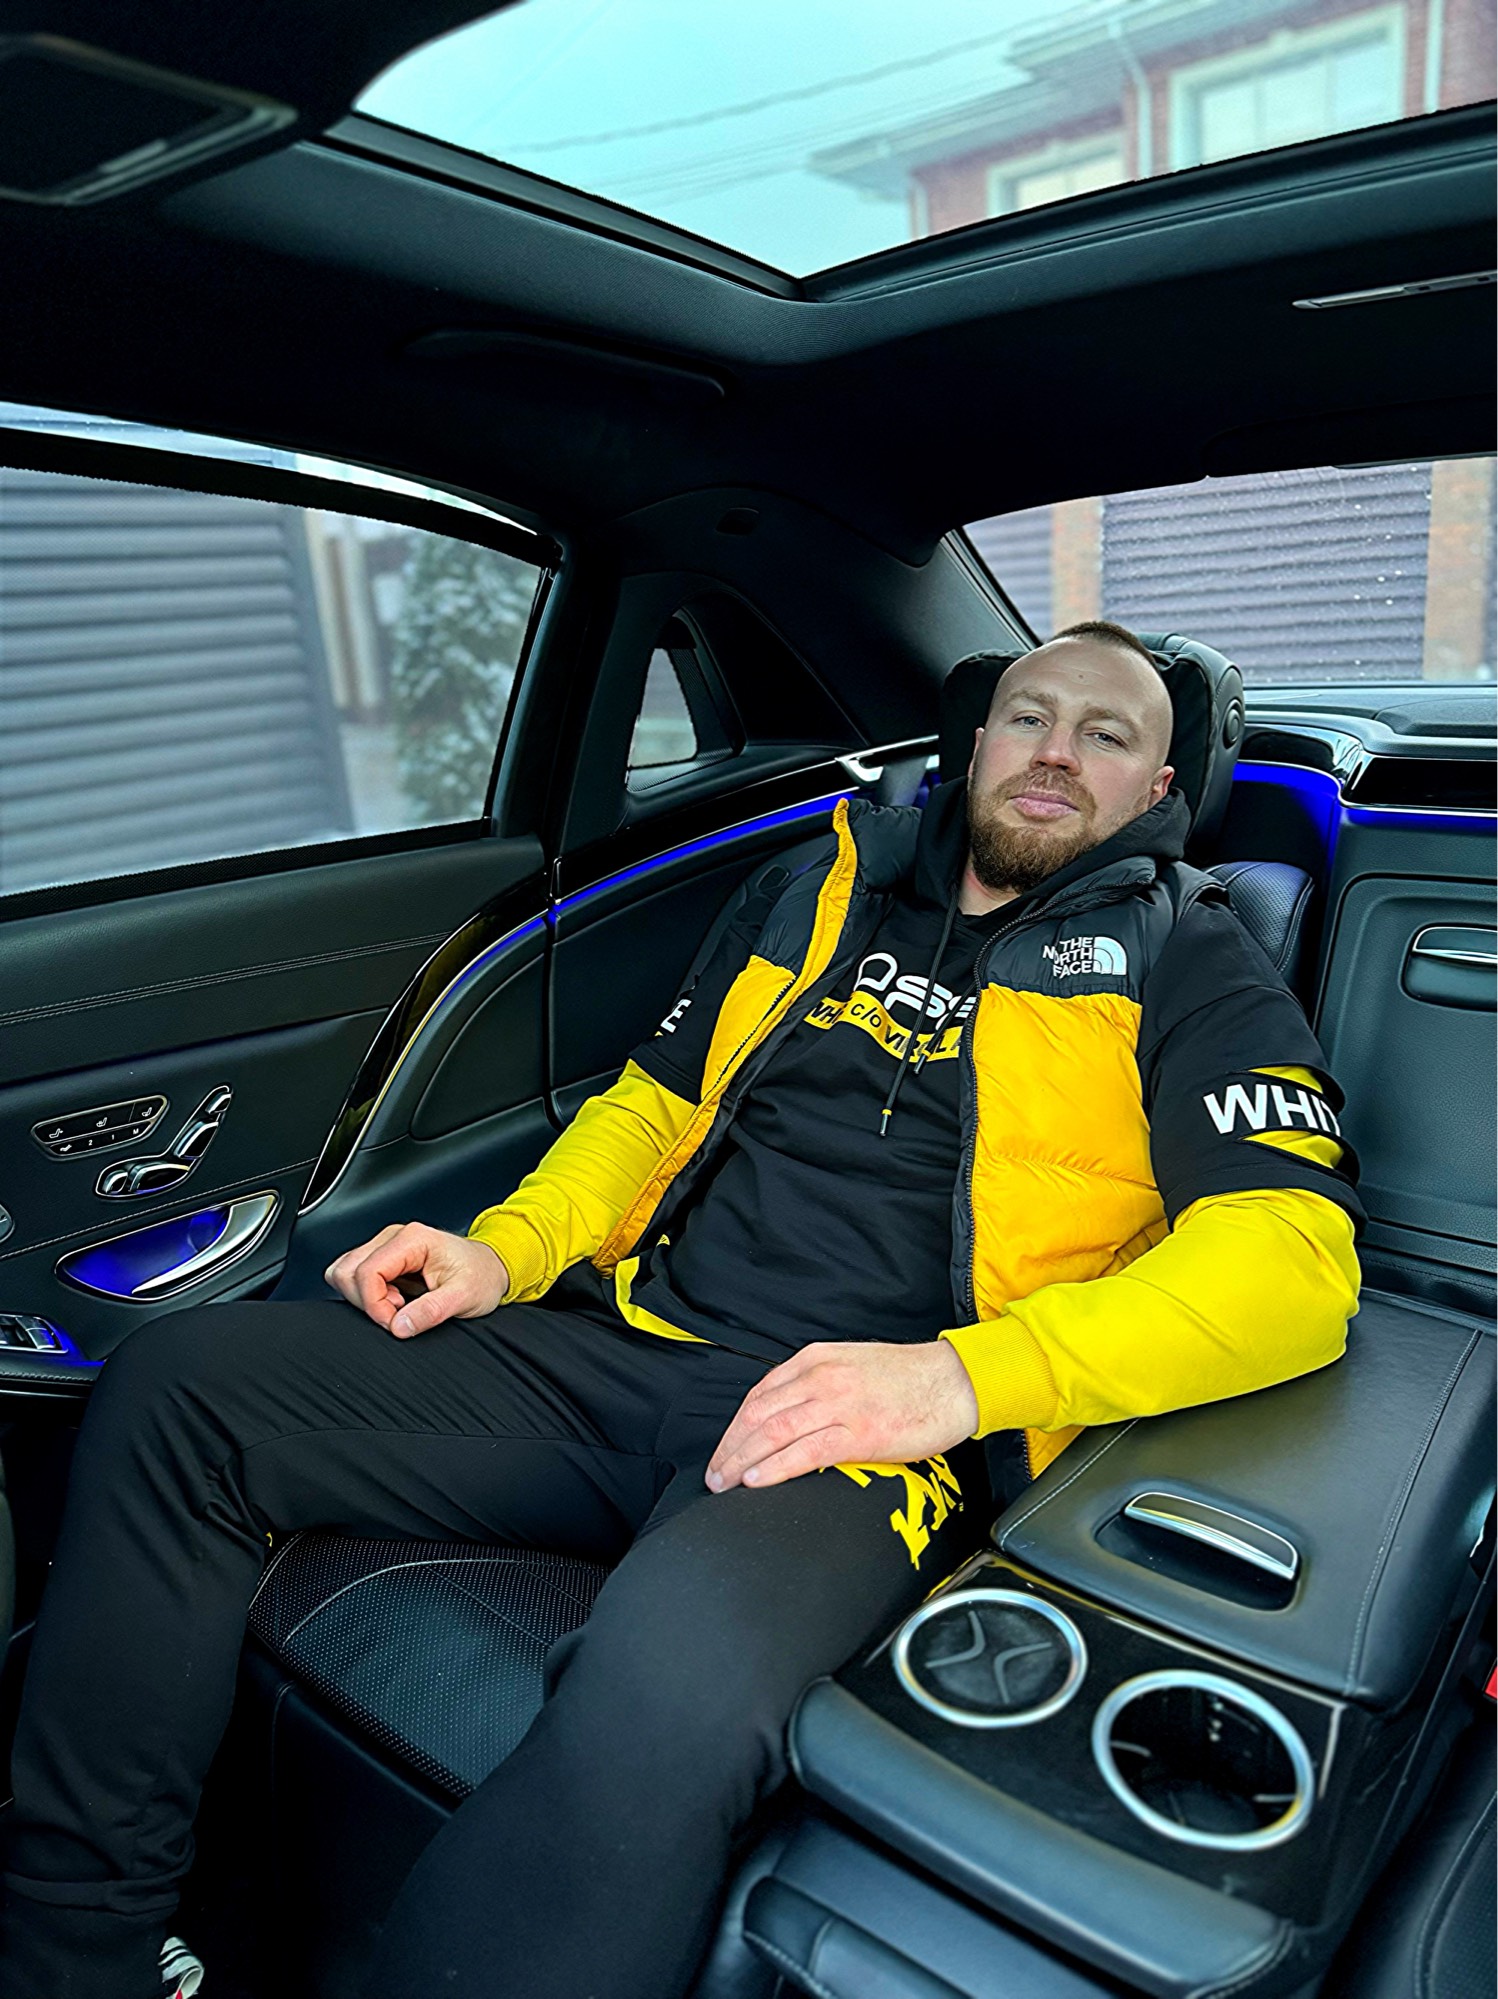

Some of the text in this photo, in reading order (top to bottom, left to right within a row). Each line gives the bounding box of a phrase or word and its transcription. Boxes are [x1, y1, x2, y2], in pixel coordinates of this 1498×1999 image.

[1059, 936, 1094, 953] THE
[1042, 945, 1093, 966] NORTH
[1052, 960, 1093, 979] FACE
